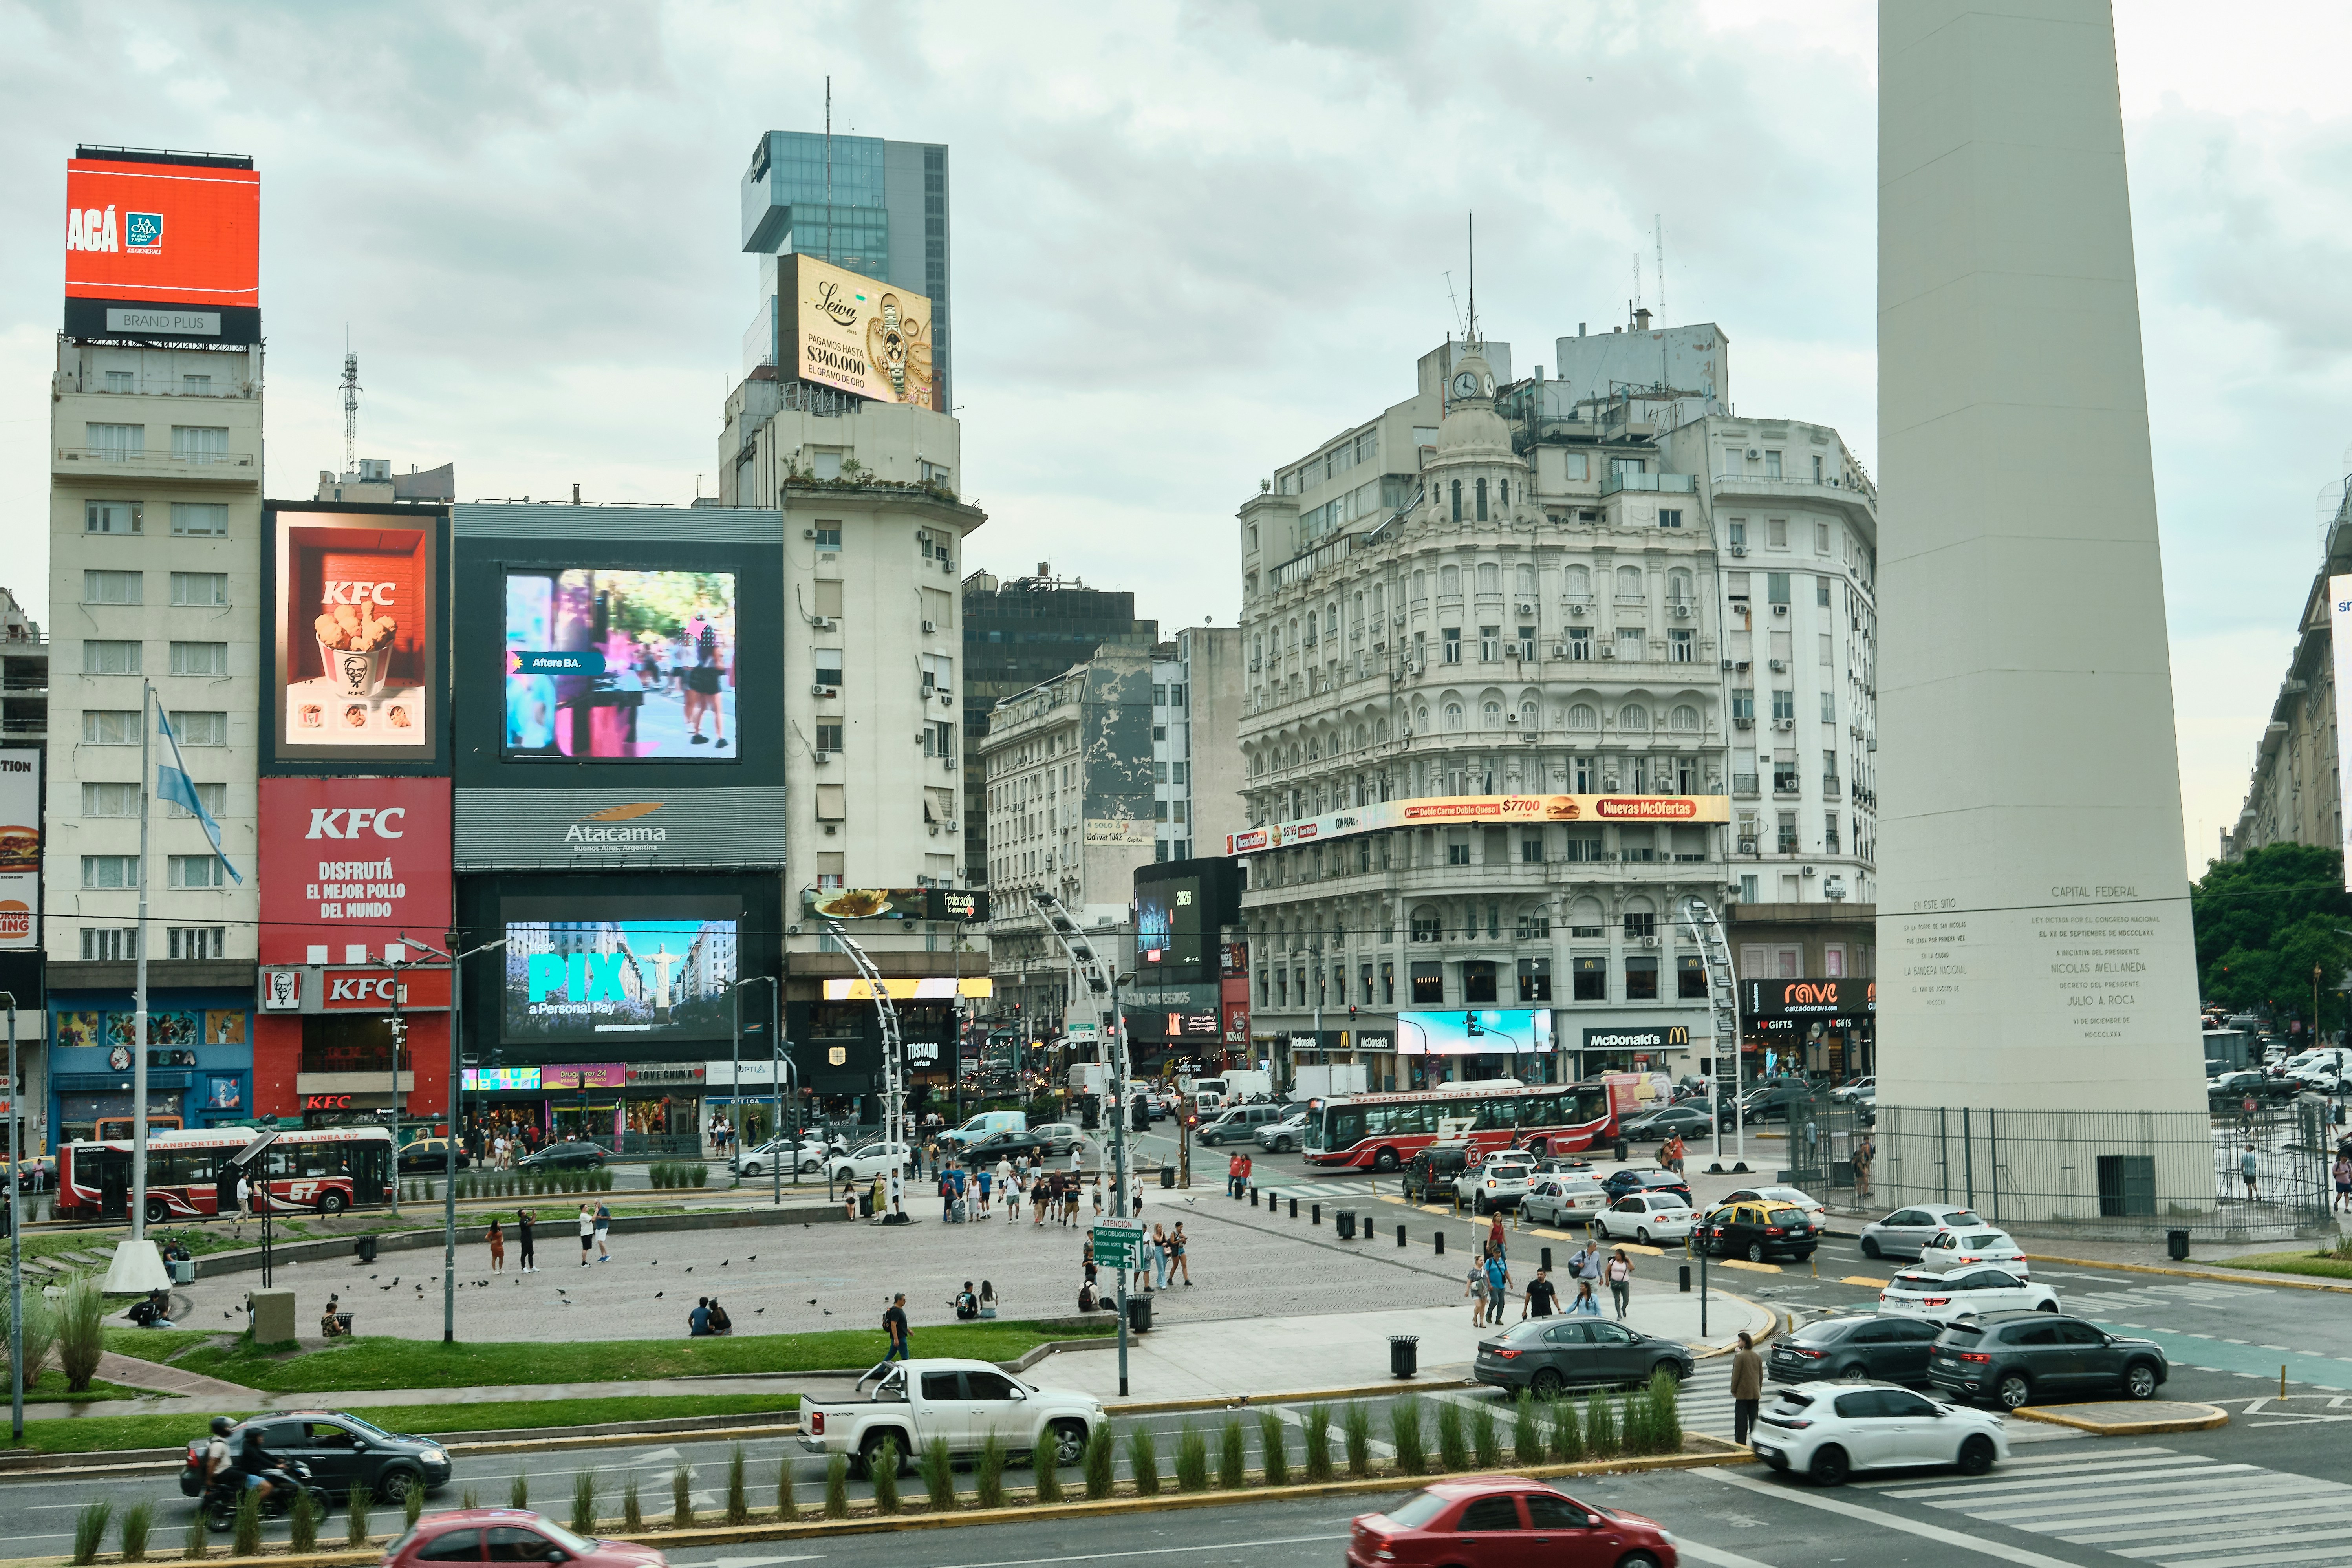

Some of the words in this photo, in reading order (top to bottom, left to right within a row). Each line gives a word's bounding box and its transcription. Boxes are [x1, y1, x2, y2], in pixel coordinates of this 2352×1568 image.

[67, 205, 118, 252] ACÁ
[138, 218, 152, 226] LA
[131, 225, 157, 235] CAJA
[815, 281, 857, 326] Leiva
[124, 315, 169, 327] BRAND
[174, 317, 203, 329] PLUS
[808, 333, 841, 351] PAGAMOS
[842, 344, 864, 359] HASTA
[807, 344, 864, 376] $340.000
[809, 364, 816, 374] EL
[817, 367, 840, 381] GRAMO
[842, 374, 850, 384] DE
[851, 377, 864, 388] ORO
[320, 581, 396, 606] KFC
[533, 658, 562, 667] Afters
[564, 659, 581, 668] BA.
[0, 760, 31, 772] TION
[1420, 806, 1437, 816] Doble
[1437, 807, 1455, 815] Carne
[1456, 805, 1475, 814] Doble
[1503, 799, 1540, 812] $7700
[1603, 801, 1639, 814] Nuevas
[1640, 801, 1691, 815] McOfertas
[305, 807, 405, 839] KFC
[564, 825, 666, 842] Atacama
[319, 857, 393, 880] DISFRUTÁ
[306, 884, 321, 899] EL
[323, 884, 364, 899] MEJOR
[367, 883, 406, 898] POLLO
[2052, 886, 2090, 897] CAPITAL
[2096, 886, 2138, 897] FEDERAL
[1176, 891, 1192, 906] 2026
[1914, 901, 1921, 911] EN
[1924, 900, 1938, 909] ESTE
[1941, 898, 1956, 908] SITIO
[321, 903, 344, 918] DEL
[346, 902, 392, 918] MUNDO
[0, 920, 29, 931] ING
[529, 941, 555, 953] Llegó
[2051, 963, 2090, 973] NICOLAS
[2095, 962, 2147, 973] AVELLANEDA
[529, 953, 626, 1001] PIX
[329, 978, 394, 1001] KFC
[1785, 983, 1838, 1004] rave
[2067, 996, 2093, 1006] JULIO
[2109, 995, 2134, 1005] ROCA
[529, 1005, 537, 1014] a
[539, 1003, 592, 1014] Personal
[593, 1002, 615, 1016] Pay
[1292, 1037, 1316, 1047] McDonald's
[1361, 1037, 1388, 1047] McDonald's
[1591, 1034, 1660, 1046] McDonald's
[907, 1043, 938, 1060] TOSTADO
[638, 1071, 660, 1079] LOVE
[664, 1070, 692, 1078] CHUKA
[306, 1095, 351, 1109] KFC
[148, 1140, 224, 1149] TRANSPORTES
[289, 1182, 318, 1200] 67
[1103, 1219, 1132, 1228] ATENCIÓN
